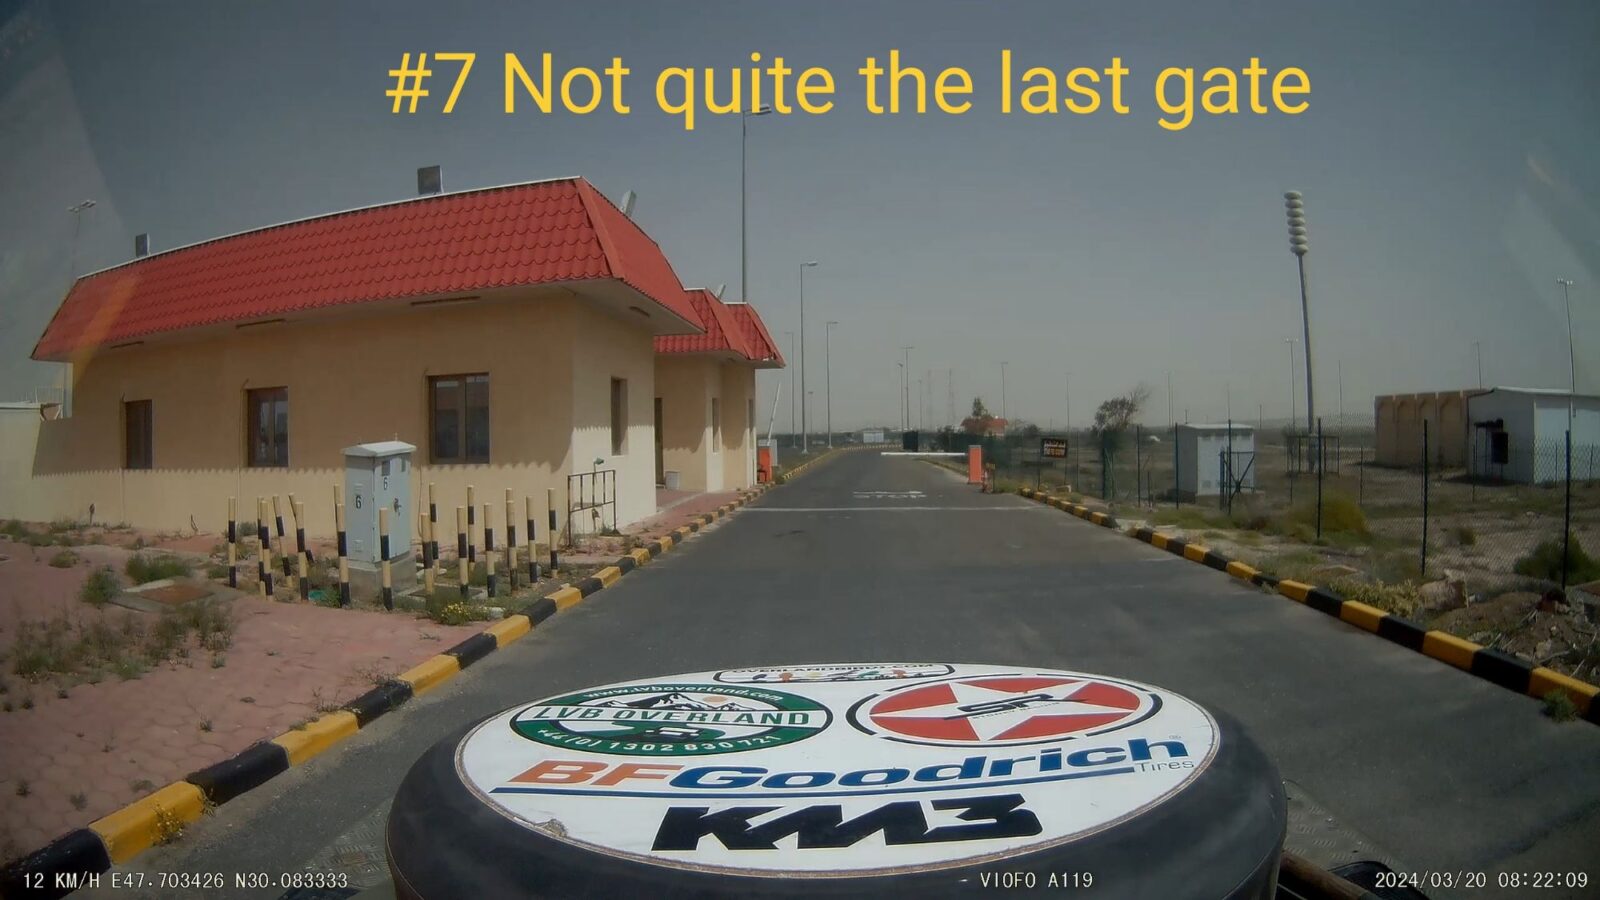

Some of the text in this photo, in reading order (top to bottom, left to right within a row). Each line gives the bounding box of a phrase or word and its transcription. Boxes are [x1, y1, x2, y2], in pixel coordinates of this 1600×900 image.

[383, 476, 388, 490] 6
[355, 494, 362, 509] 6
[583, 686, 784, 701] www.lvboverland.com
[533, 706, 811, 726] LVB OVERLAND
[608, 742, 674, 751] 1302
[684, 742, 734, 751] 830
[737, 735, 782, 746] 721
[506, 738, 1188, 789] BFGoodrich
[1135, 760, 1194, 772] Tires
[651, 793, 1043, 851] KM3
